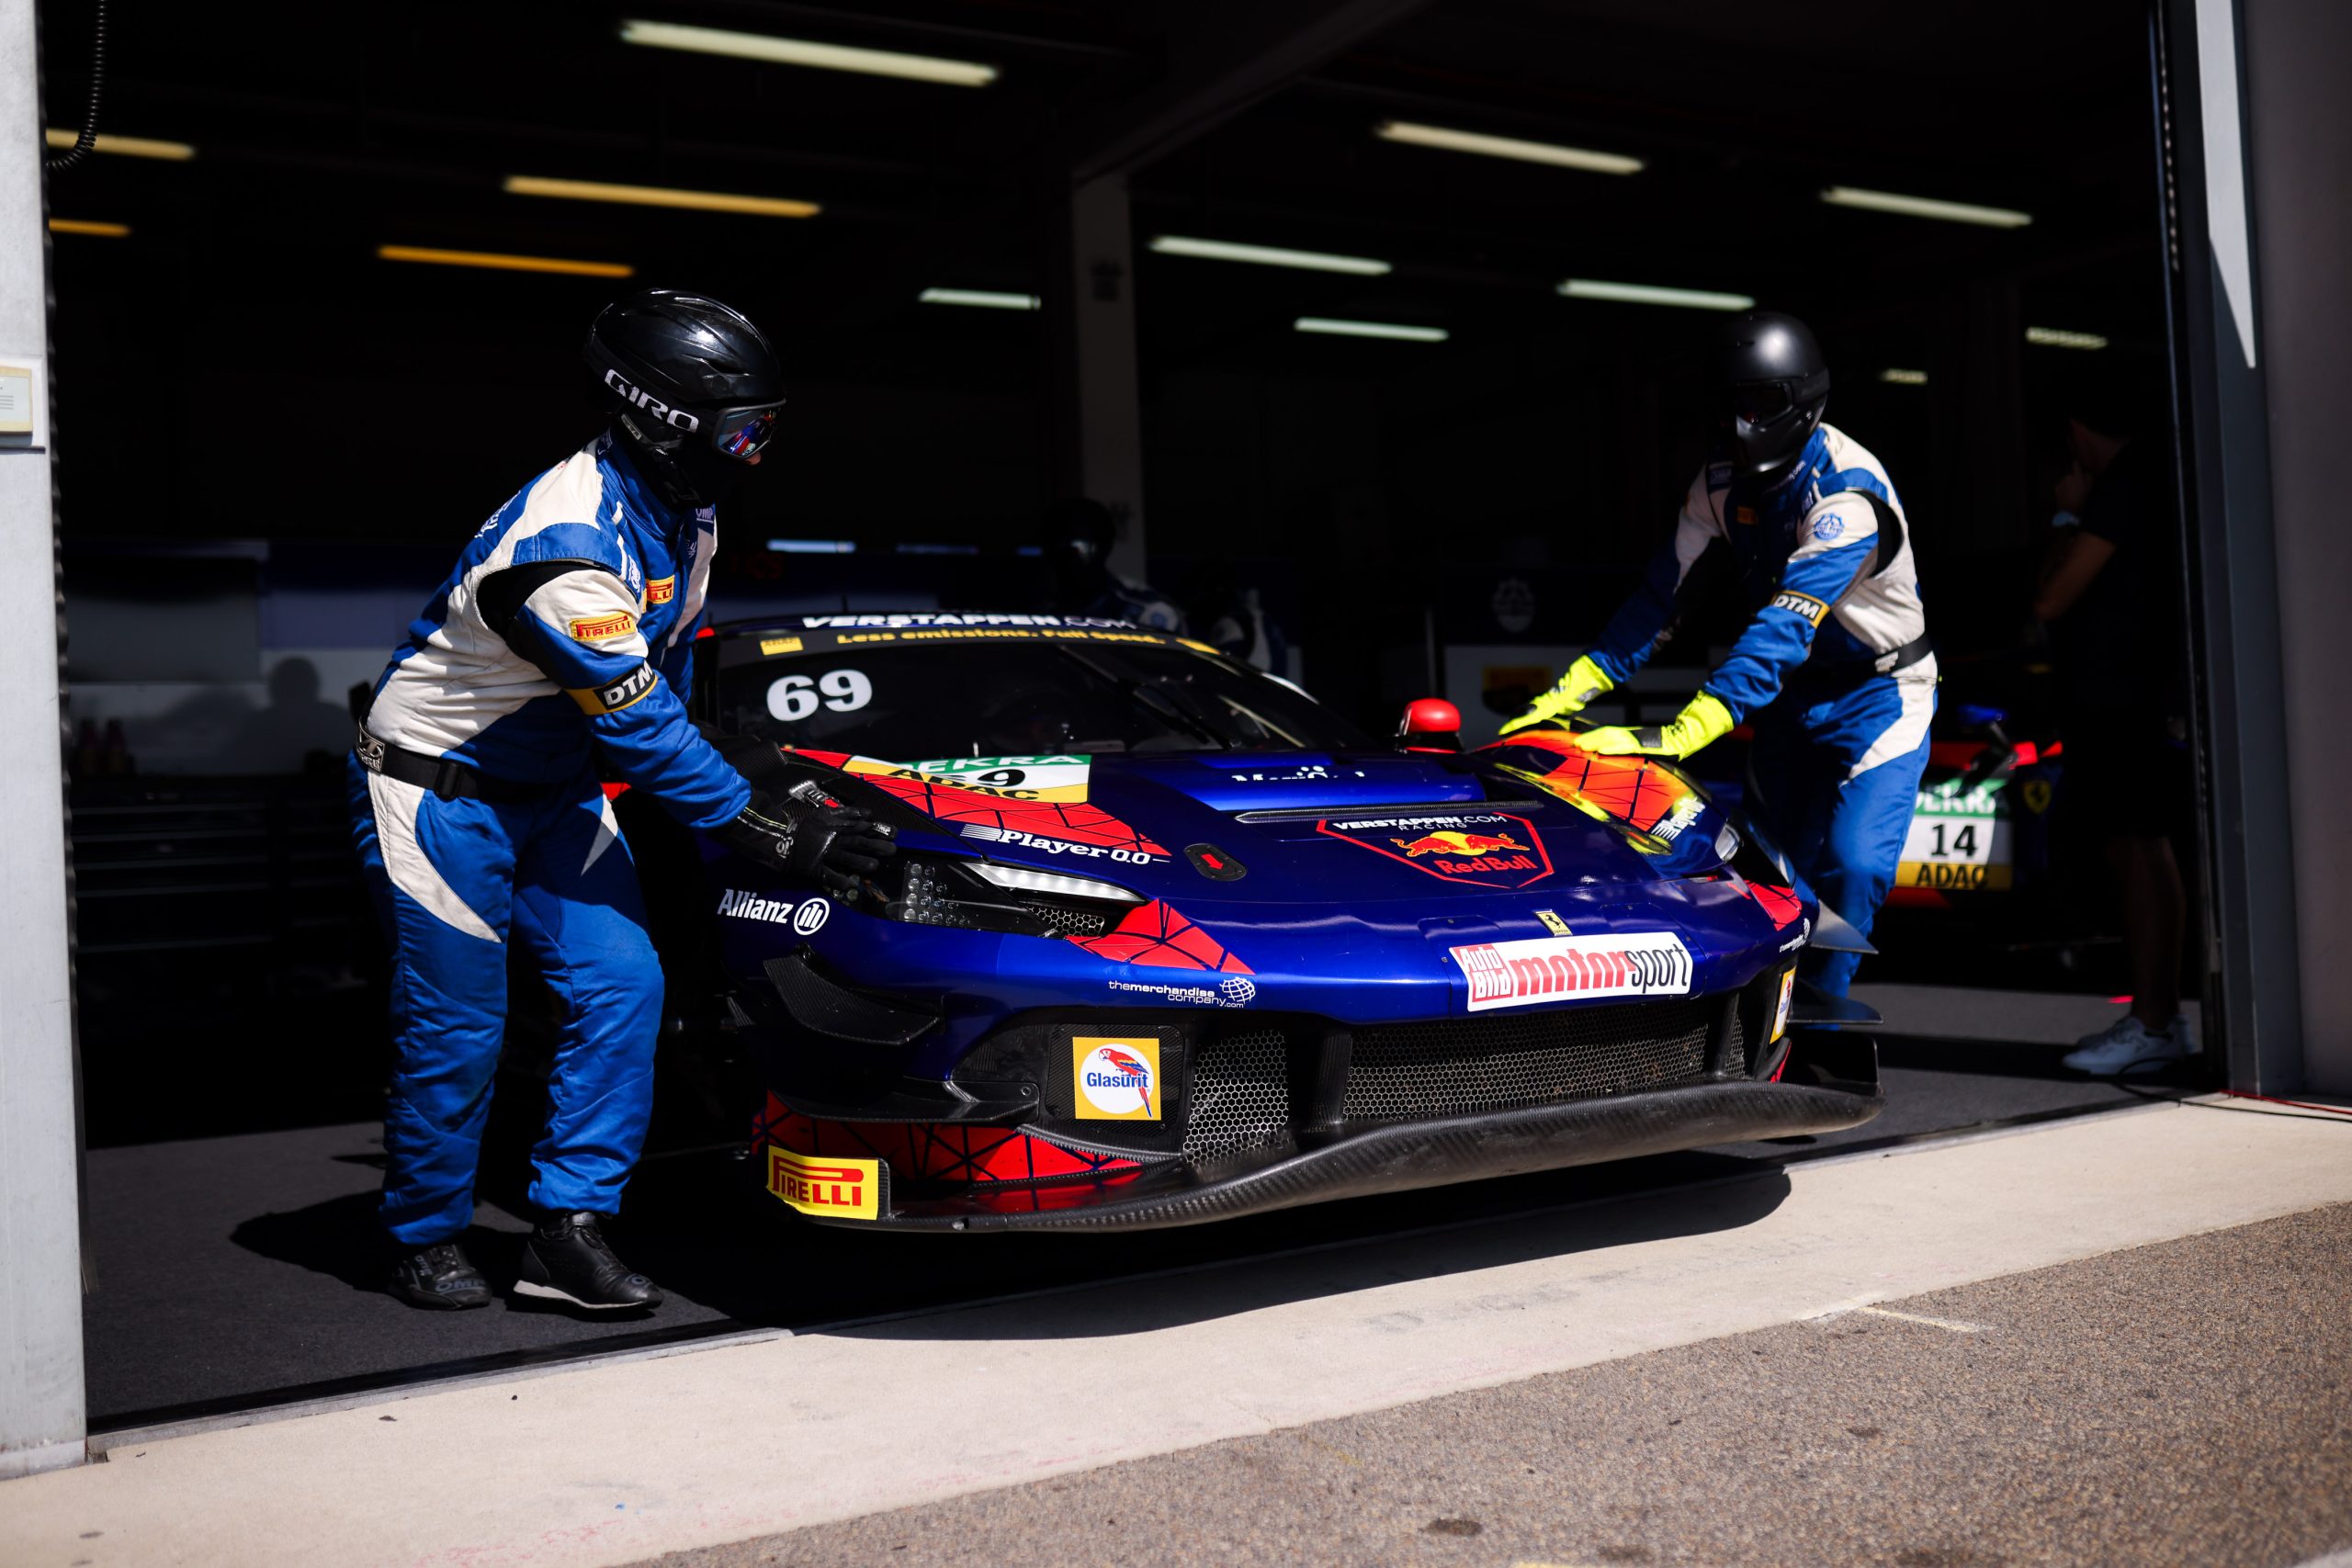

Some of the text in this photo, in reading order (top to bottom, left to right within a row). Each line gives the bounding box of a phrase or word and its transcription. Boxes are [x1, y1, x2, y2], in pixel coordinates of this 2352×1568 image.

[605, 368, 699, 434] GIRO
[1774, 594, 1820, 619] DTM
[576, 615, 631, 637] PIRELLI
[837, 634, 897, 644] Less
[604, 659, 654, 706] DTM
[766, 669, 873, 722] 69
[1332, 815, 1508, 830] VERSTAPPEN.COM
[1398, 822, 1467, 831] RACING
[999, 829, 1151, 865] Player 0.0
[1931, 824, 1977, 857] 14
[1916, 864, 1987, 889] ADAC
[718, 888, 794, 924] Allianz
[1458, 946, 1504, 972] Auto
[1108, 980, 1216, 998] themerchandise
[1471, 968, 1510, 998] Bild
[1168, 993, 1244, 1008] company.com
[1087, 1072, 1148, 1089] Glasurit
[773, 1155, 865, 1206] PIRELLI
